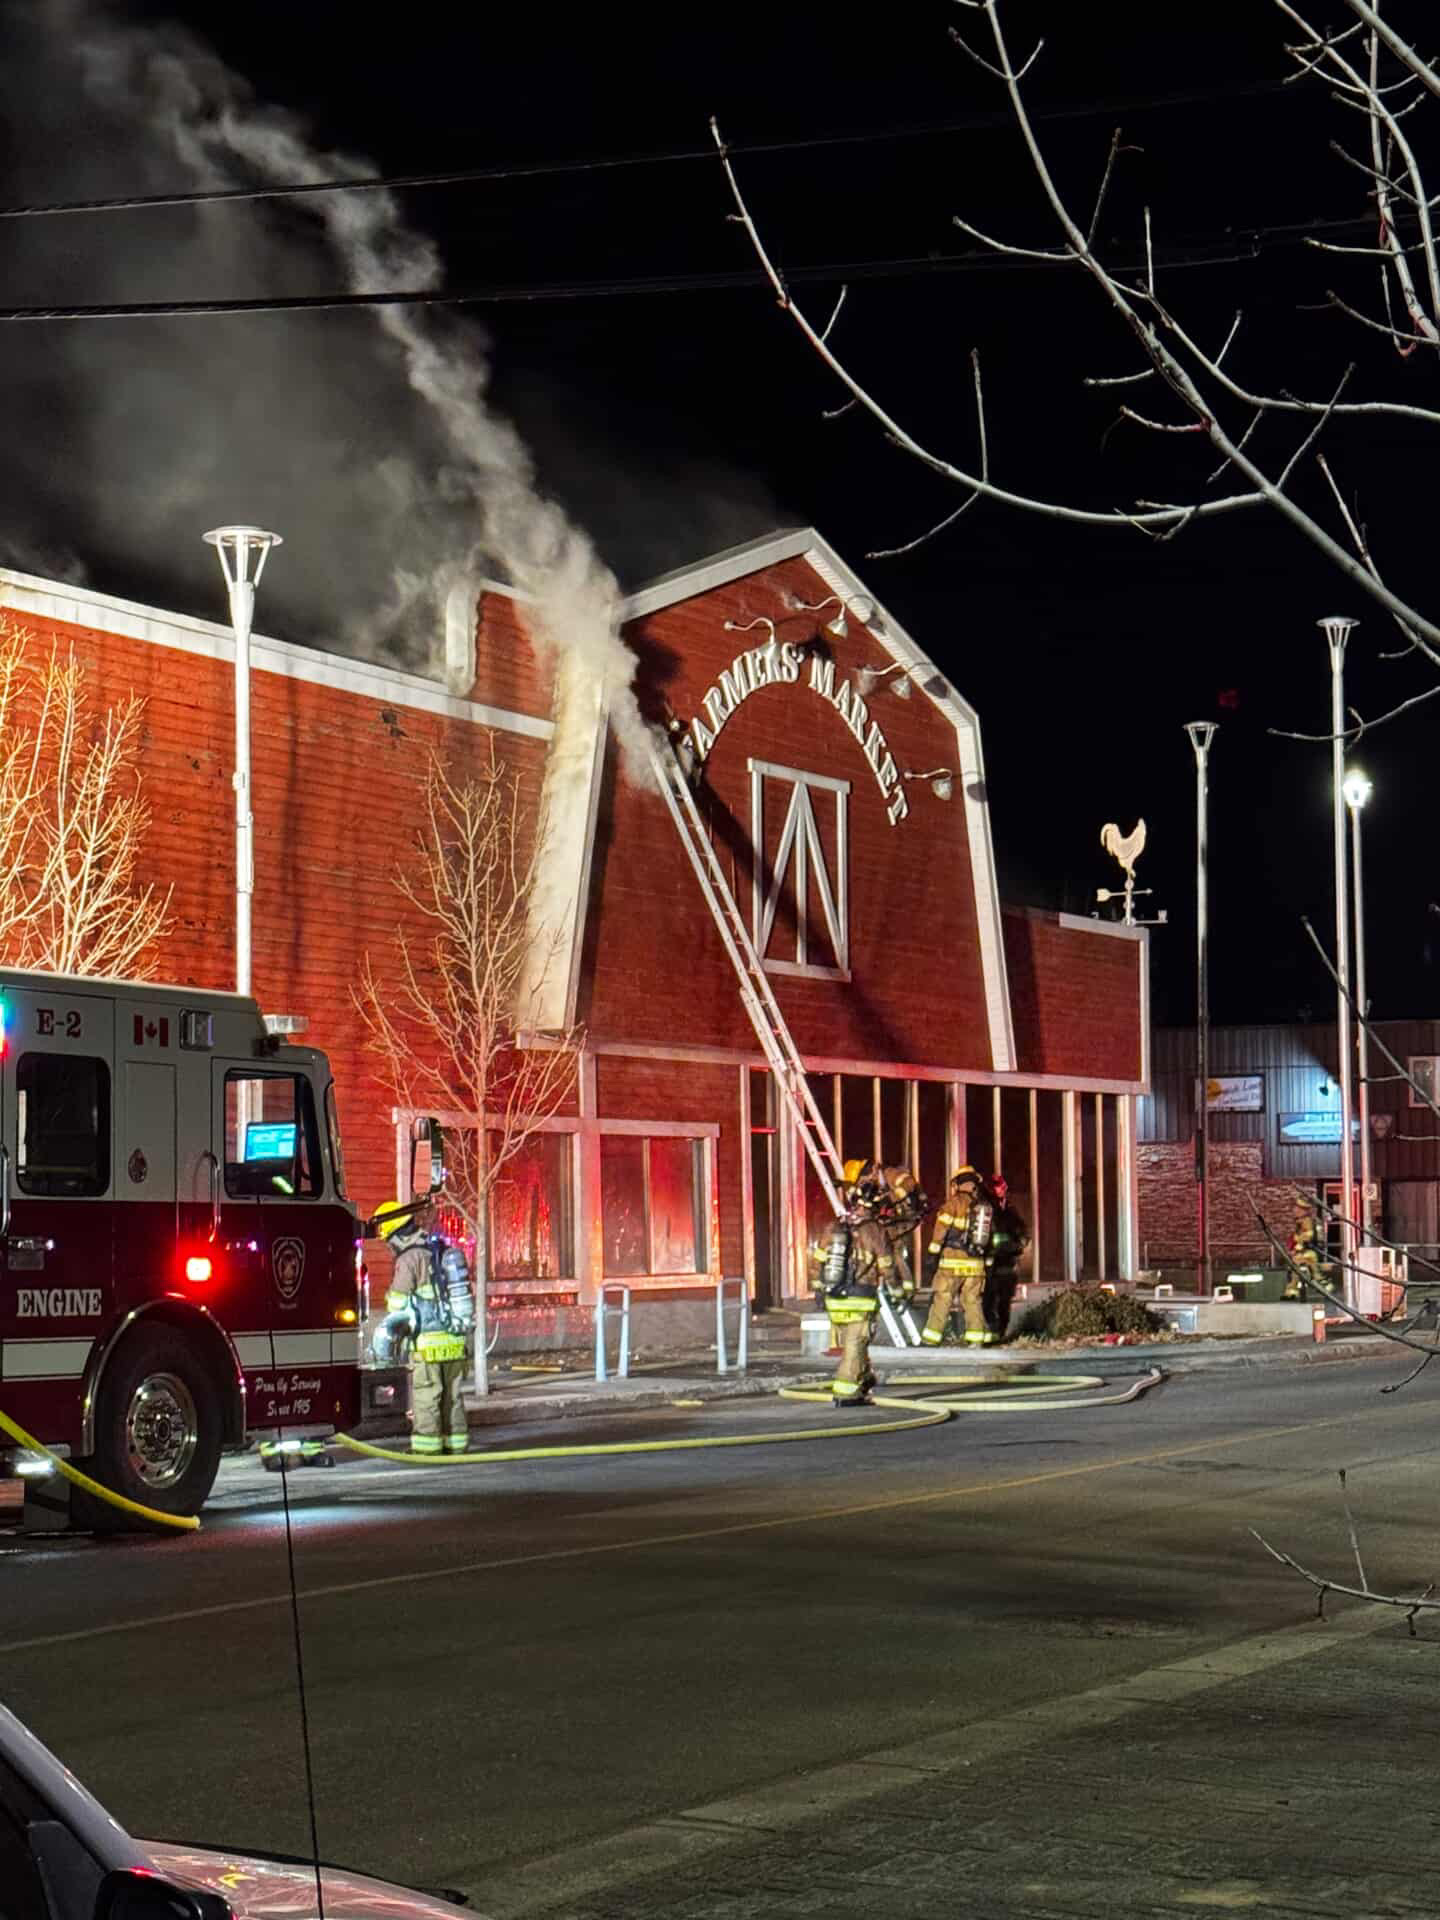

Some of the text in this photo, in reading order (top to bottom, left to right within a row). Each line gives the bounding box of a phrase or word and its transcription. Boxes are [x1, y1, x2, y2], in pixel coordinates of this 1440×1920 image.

[682, 641, 909, 826] ARMERS' MARKET
[36, 1008, 82, 1038] E-2
[16, 1288, 102, 1317] ENGINE
